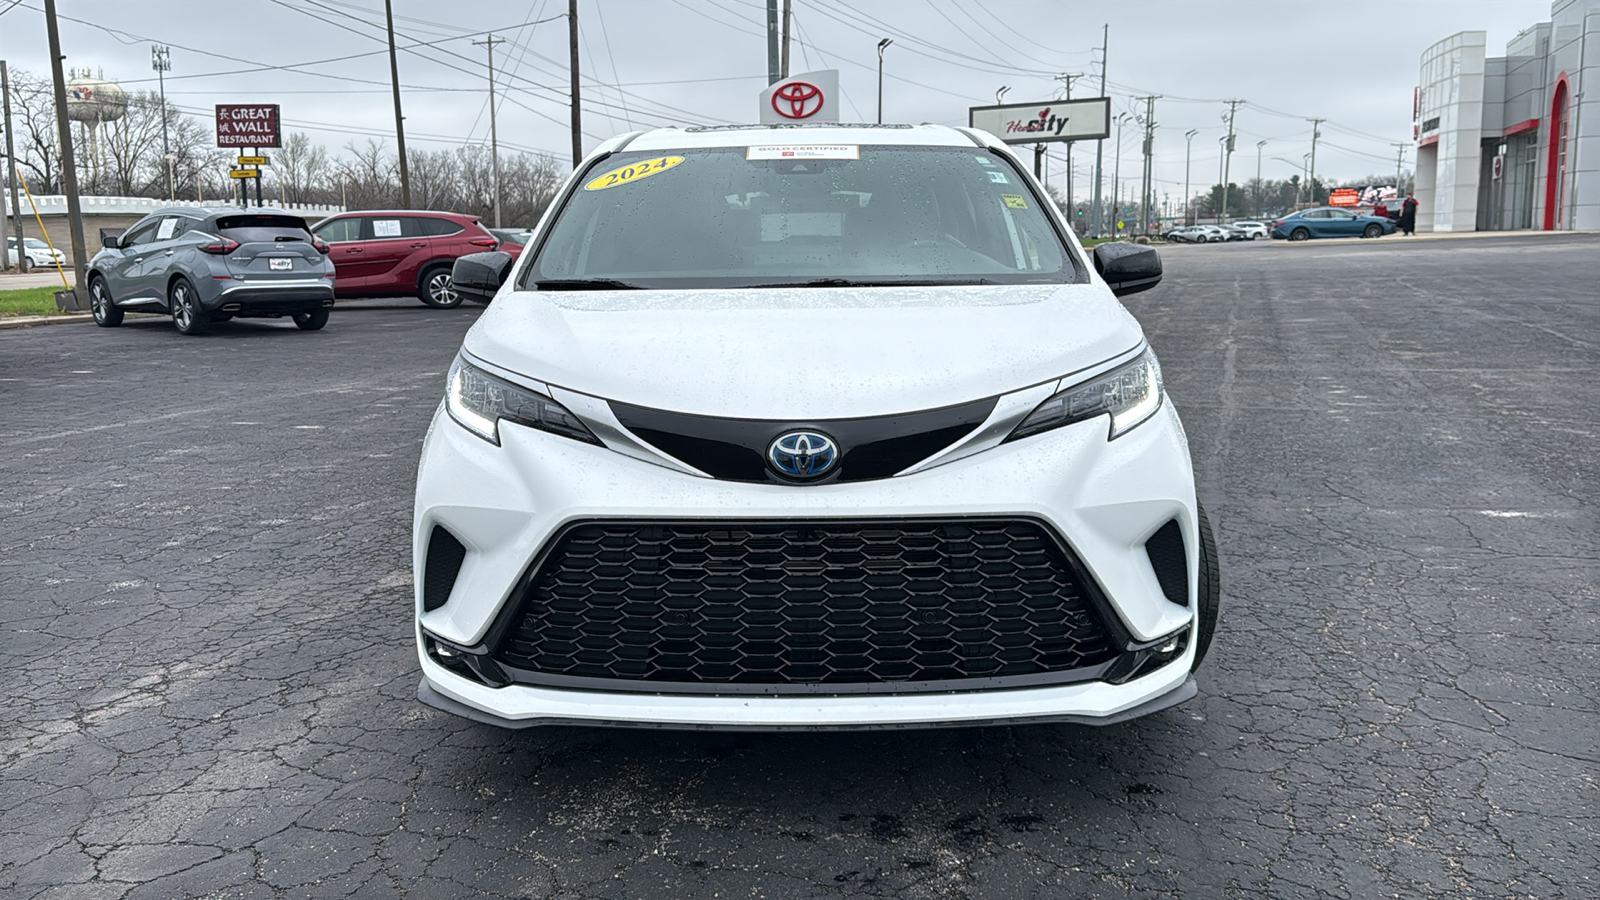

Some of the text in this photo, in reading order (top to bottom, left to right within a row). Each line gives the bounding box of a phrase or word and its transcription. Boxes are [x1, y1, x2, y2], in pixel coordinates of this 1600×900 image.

[231, 108, 272, 119] GREAT
[232, 121, 271, 133] WALL
[1026, 108, 1069, 135] city
[219, 135, 275, 144] RESTAURANT
[605, 158, 668, 186] 2024
